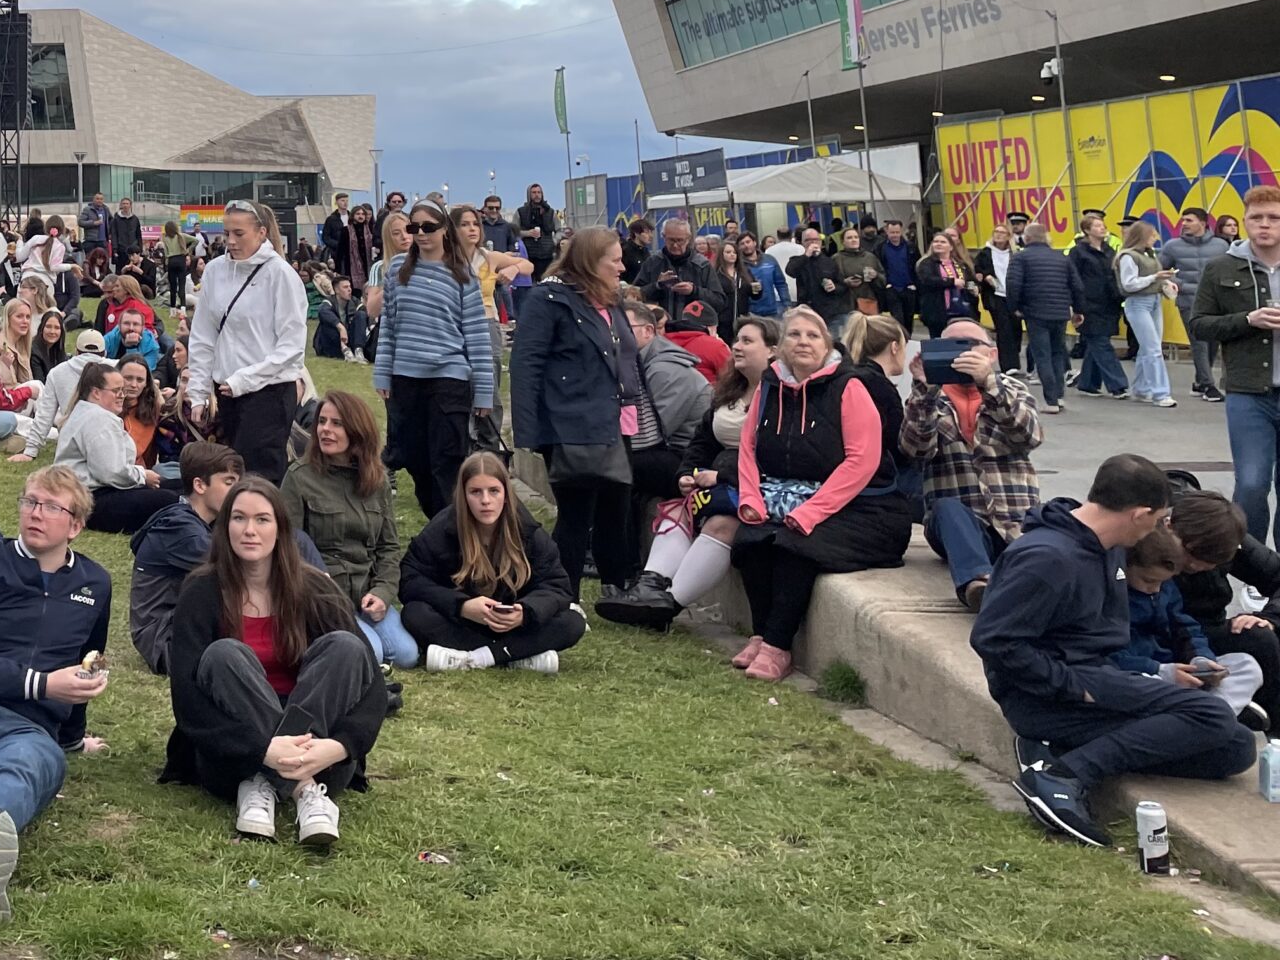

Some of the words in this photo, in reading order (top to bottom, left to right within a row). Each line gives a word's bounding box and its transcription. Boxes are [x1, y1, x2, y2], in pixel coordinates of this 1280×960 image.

[681, 18, 703, 45] The
[703, 1, 746, 38] ultimate
[947, 136, 1031, 186] UNITED
[953, 191, 982, 234] BY
[990, 185, 1069, 234] MUSIC
